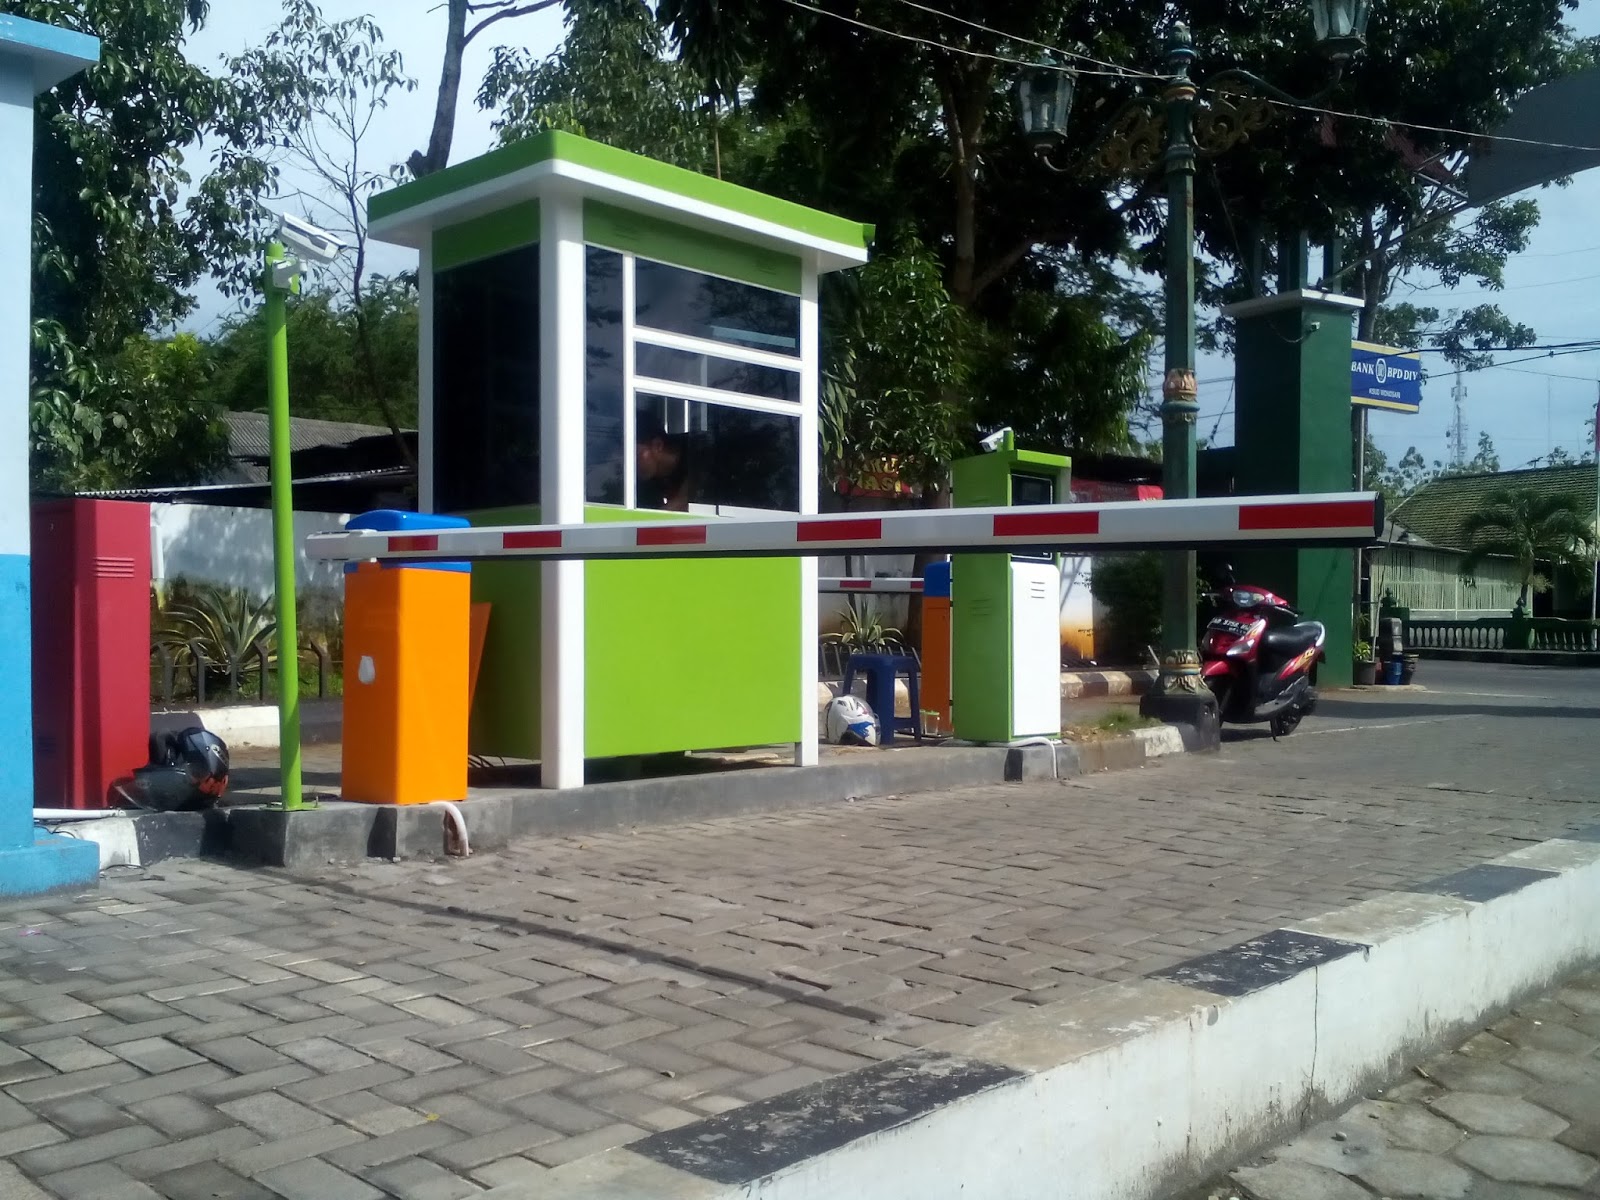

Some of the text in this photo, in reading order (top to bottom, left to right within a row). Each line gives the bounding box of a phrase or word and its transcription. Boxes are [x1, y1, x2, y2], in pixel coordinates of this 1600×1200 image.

[1351, 361, 1418, 381] BANK BPD DIY
